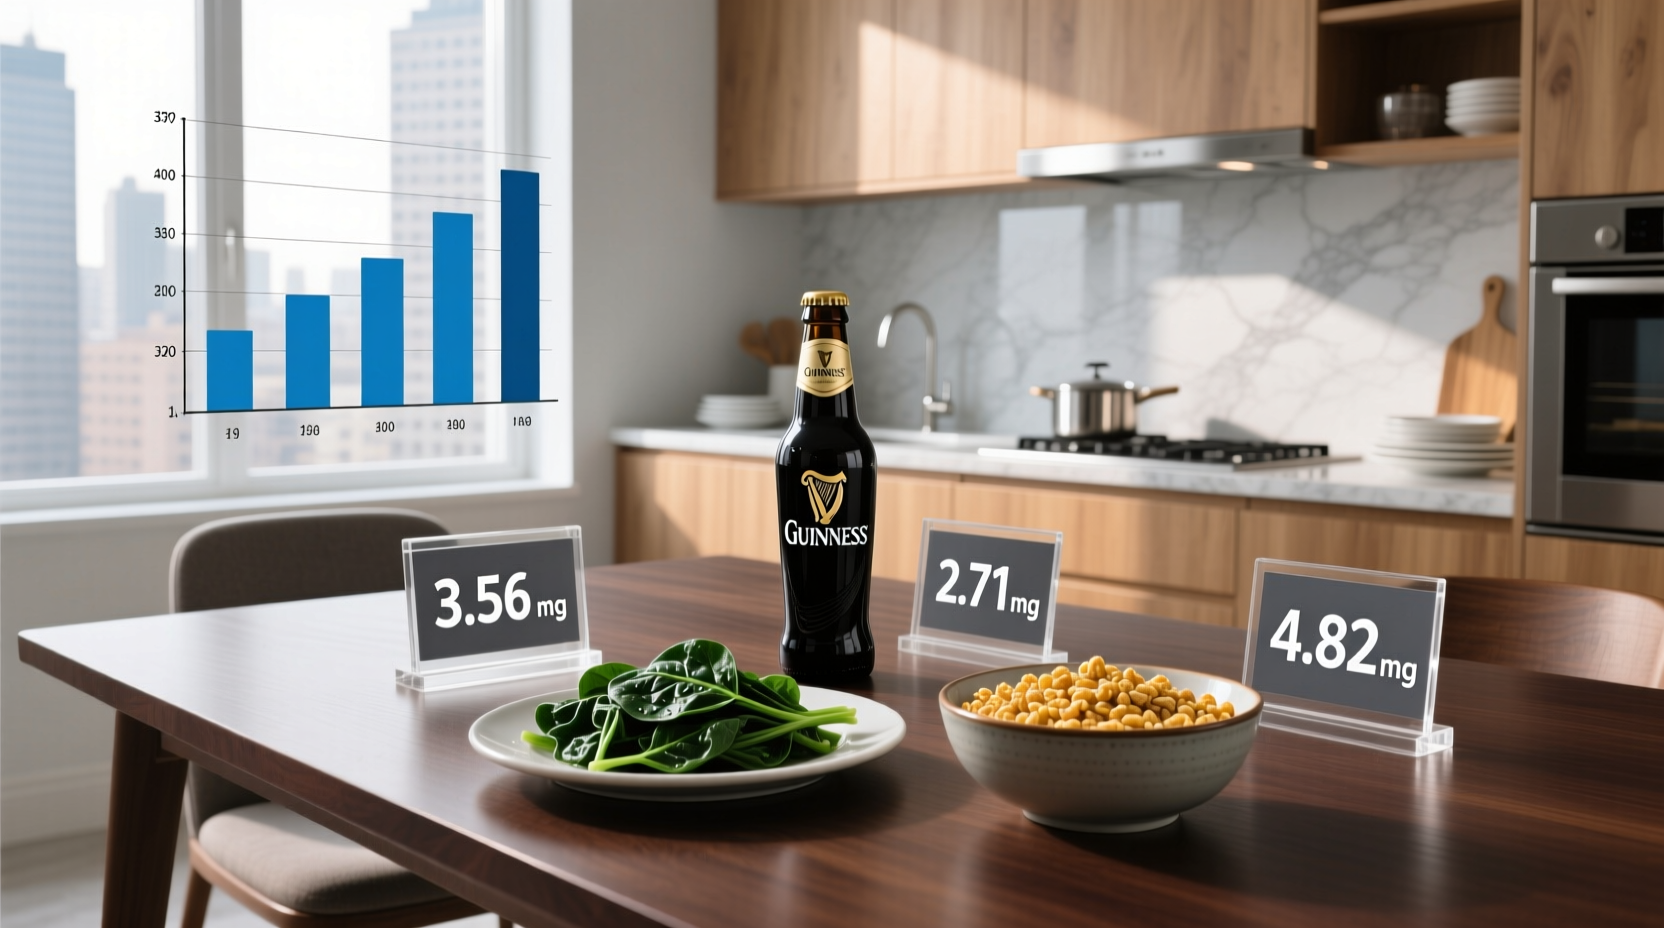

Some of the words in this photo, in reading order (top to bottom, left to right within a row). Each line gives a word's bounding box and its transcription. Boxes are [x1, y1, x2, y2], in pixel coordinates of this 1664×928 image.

[784, 519, 869, 547] GUINNESS
[434, 571, 531, 629] 3.56
[537, 598, 567, 622] mg
[935, 558, 1010, 612] 2.71
[1010, 596, 1040, 622] mg
[1269, 608, 1379, 676] 4.82
[1379, 657, 1418, 689] mg
